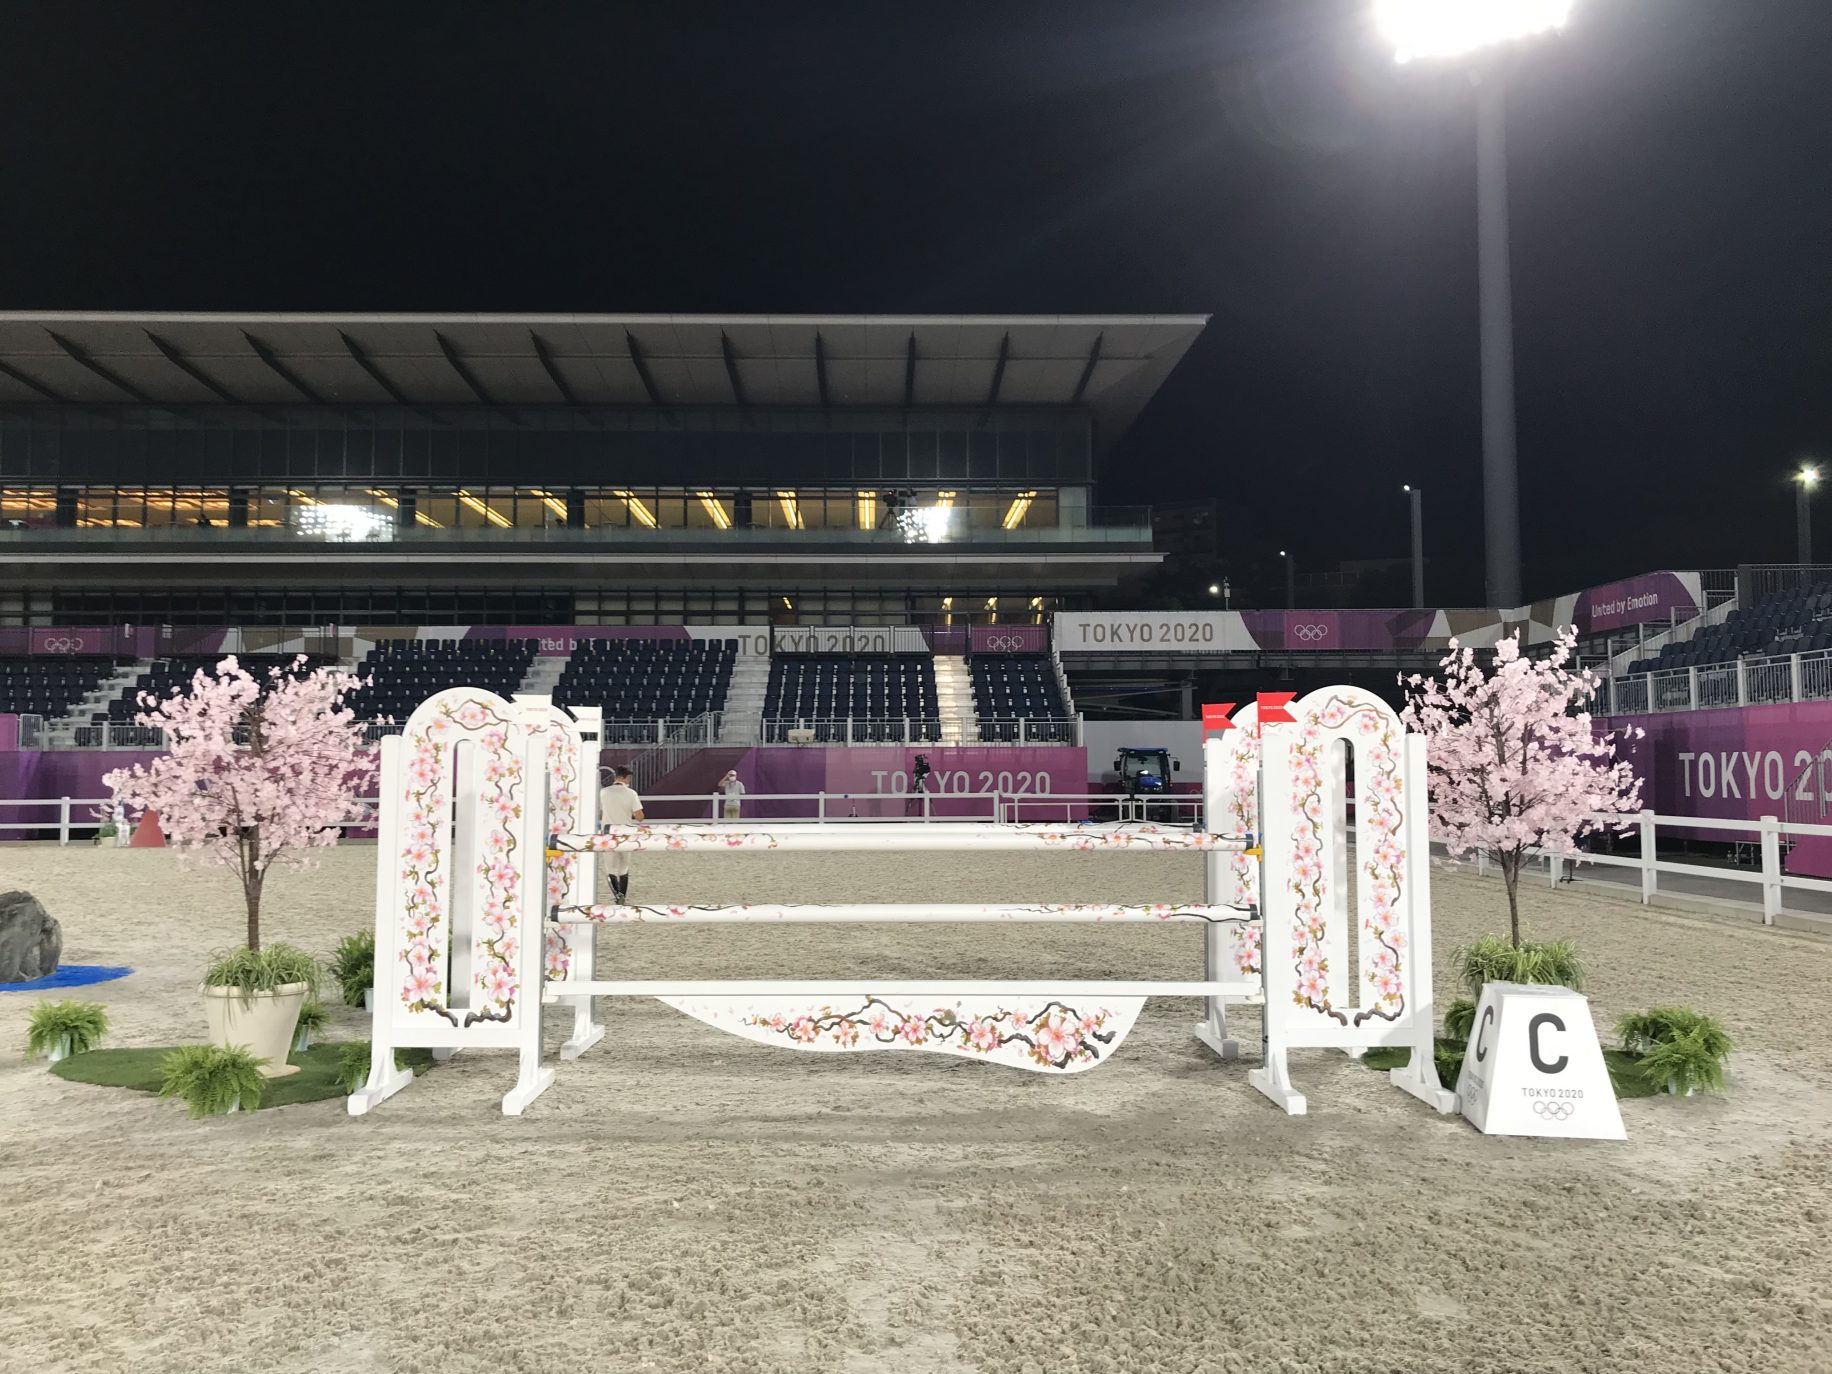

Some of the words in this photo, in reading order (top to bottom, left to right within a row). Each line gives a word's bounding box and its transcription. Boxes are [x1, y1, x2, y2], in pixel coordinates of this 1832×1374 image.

[1591, 600, 1616, 618] United
[1616, 599, 1626, 615] by
[1627, 592, 1659, 611] Emotion
[738, 634, 818, 656] TOKYO
[826, 634, 885, 653] 2020
[1078, 623, 1153, 643] TOKYO
[1159, 622, 1214, 642] 2020
[978, 770, 1051, 795] 2020
[1678, 751, 1784, 801] TOKYO
[1476, 1005, 1494, 1063] C
[1528, 1012, 1569, 1075] C
[1521, 1087, 1556, 1098] TOKYO
[1558, 1088, 1584, 1099] 2020
